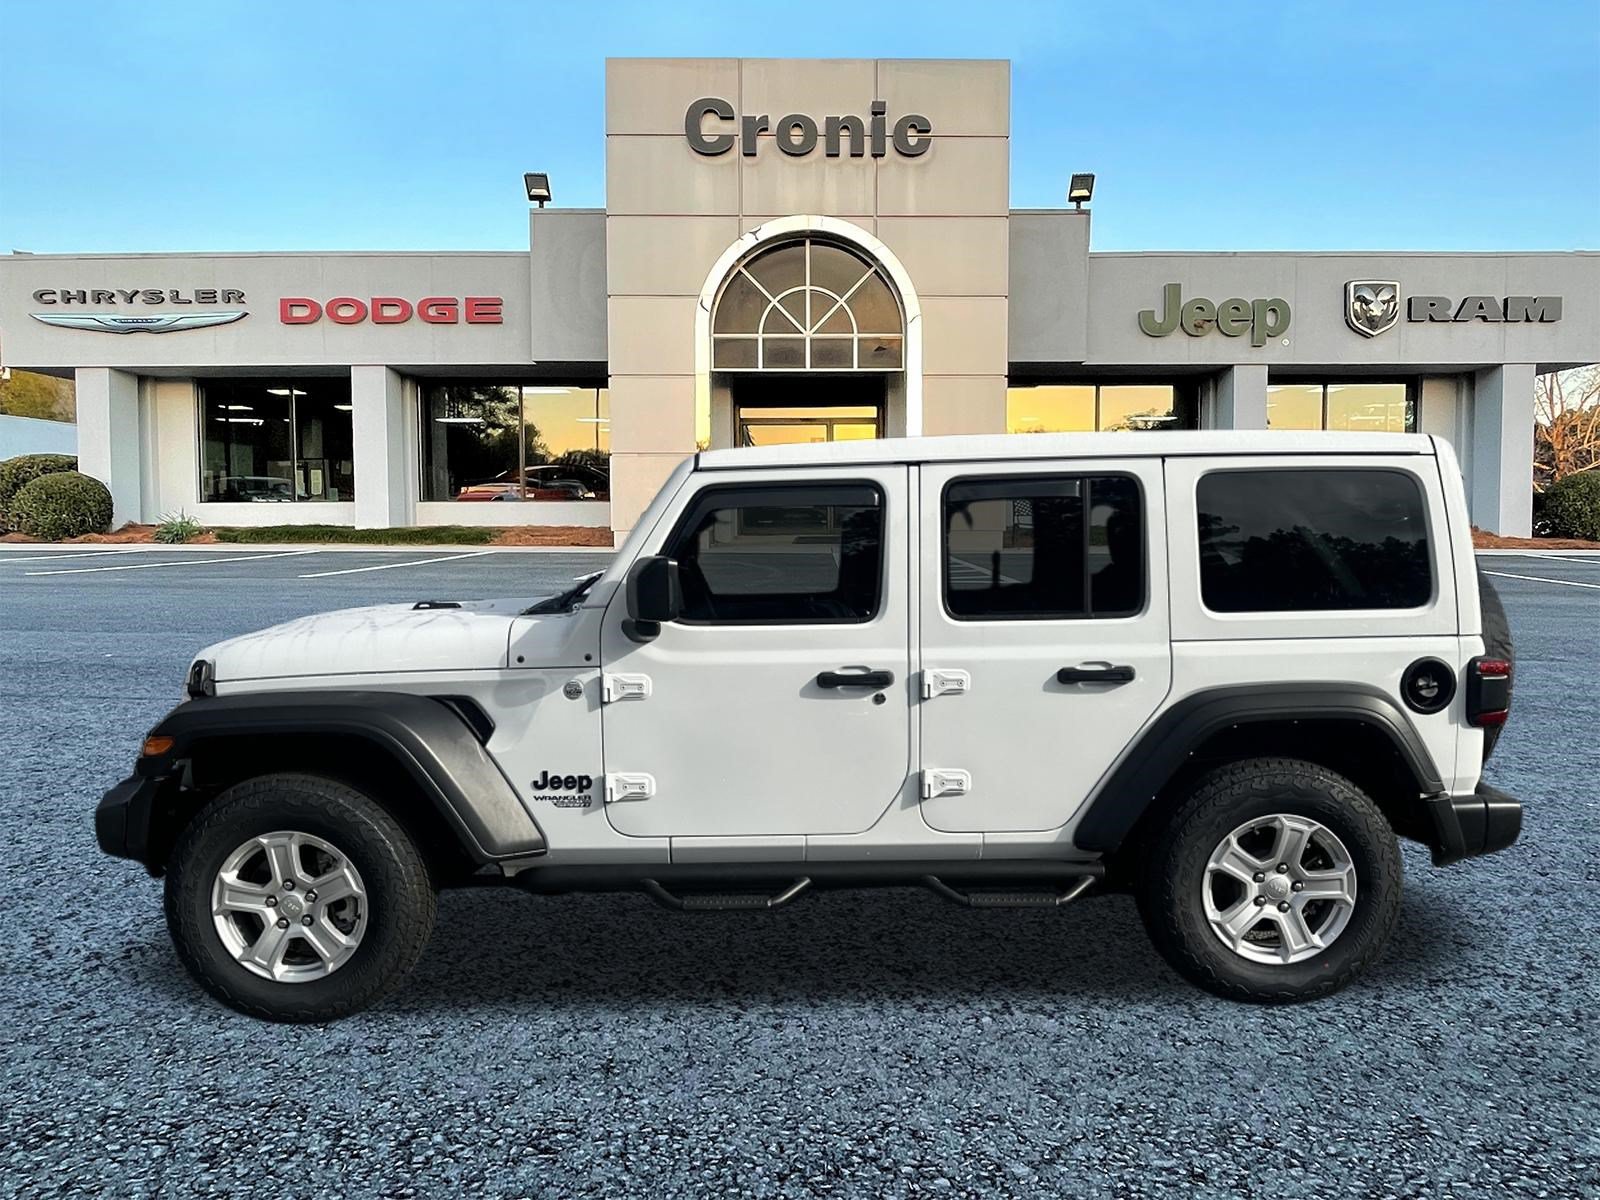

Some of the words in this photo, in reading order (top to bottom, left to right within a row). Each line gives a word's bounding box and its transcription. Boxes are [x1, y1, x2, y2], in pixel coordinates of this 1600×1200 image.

[685, 97, 932, 157] Cronic
[32, 289, 248, 305] CHRYSLER
[279, 297, 504, 324] DODGE
[1407, 296, 1563, 323] RAM
[1138, 283, 1291, 347] Jeep
[532, 770, 593, 794] Jeep
